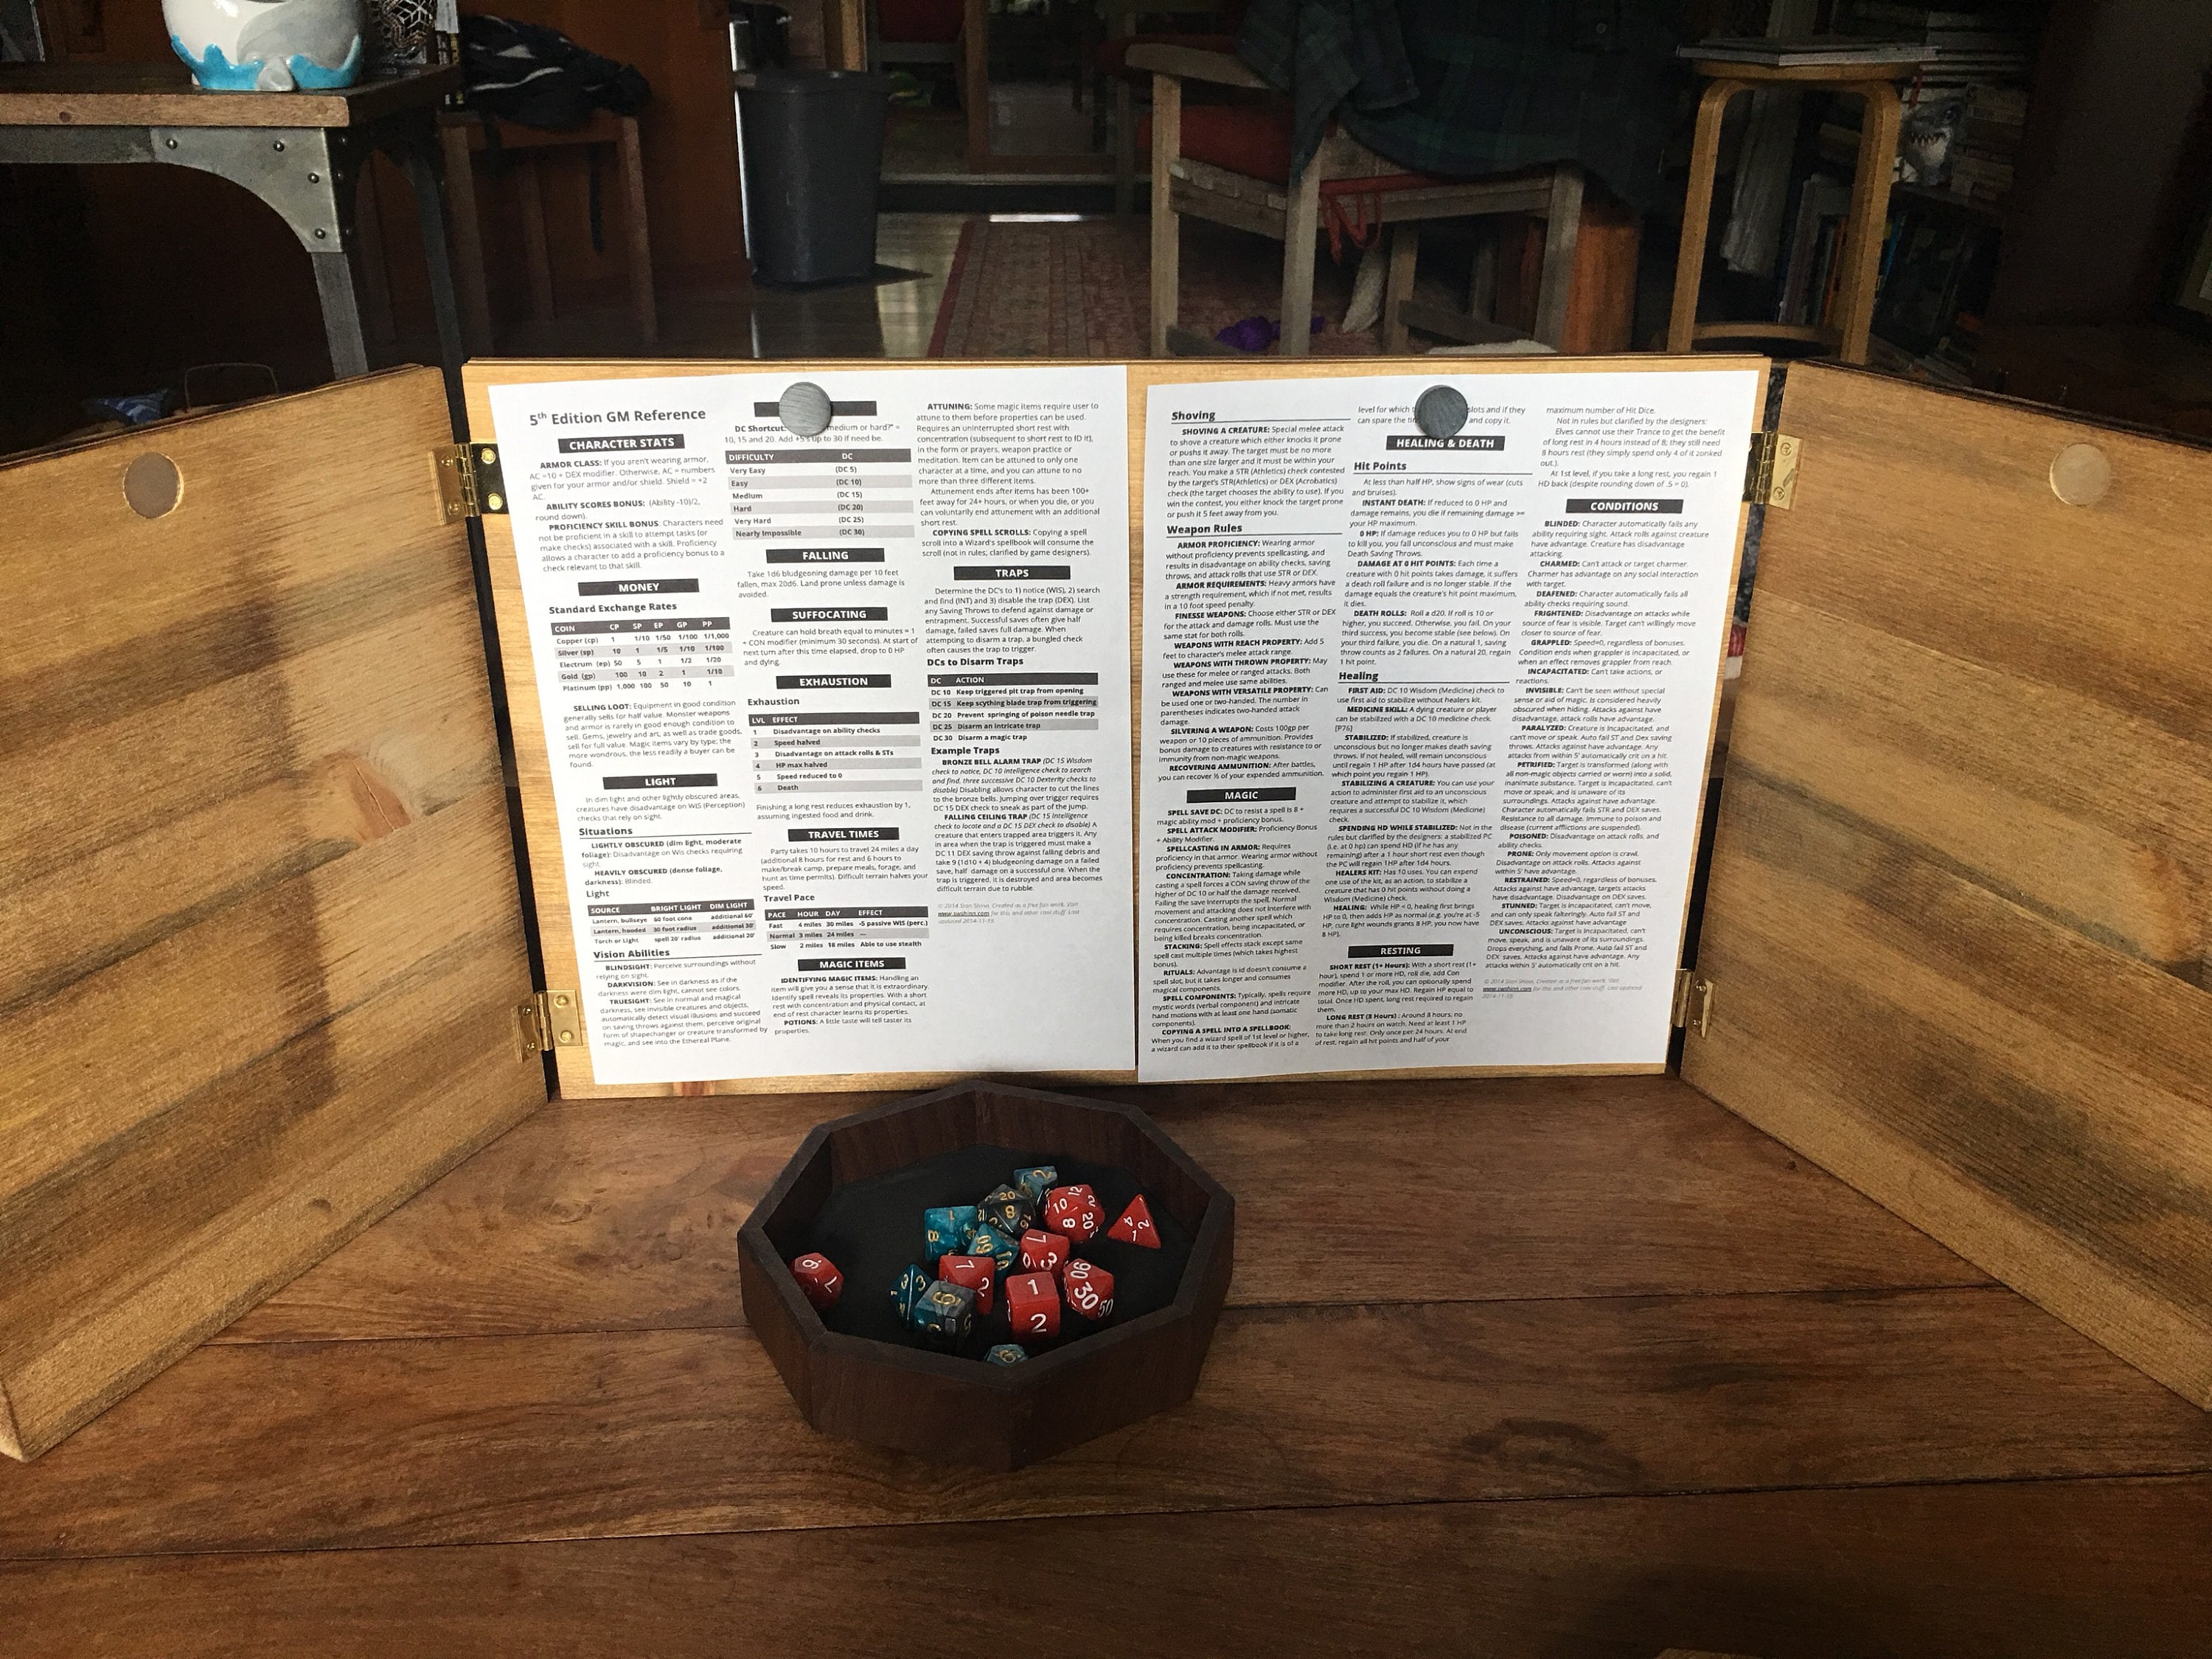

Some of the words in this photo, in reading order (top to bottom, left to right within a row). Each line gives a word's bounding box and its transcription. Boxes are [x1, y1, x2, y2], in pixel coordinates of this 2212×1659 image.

[927, 403, 973, 411] ATTUNING:
[974, 403, 996, 411] Some
[997, 403, 1020, 412] magic
[1020, 403, 1042, 411] items
[1043, 403, 1071, 411] require
[1357, 406, 1376, 414] level
[1376, 406, 1388, 414] for
[1388, 405, 1411, 414] which
[1486, 406, 1501, 414] and
[1502, 406, 1509, 414] if
[1509, 406, 1526, 416] they
[1546, 406, 1584, 414] maximum
[1585, 406, 1615, 414] number
[1615, 406, 1625, 414] of
[1625, 406, 1637, 414] Hit
[1638, 406, 1656, 414] Dice.
[551, 412, 602, 425] Edition
[606, 411, 630, 422] GM
[634, 409, 706, 422] Reference
[1171, 410, 1216, 422] Shoving
[1182, 428, 1219, 436] SHOVING
[1228, 426, 1270, 434] CREATURE:
[1271, 425, 1298, 434] Special
[568, 439, 639, 452] CHARACTER
[639, 437, 675, 448] STATS
[1397, 439, 1444, 448] HEALING
[1447, 439, 1456, 448] &
[1458, 439, 1495, 448] DEATH
[728, 453, 774, 462] DIFFICULTY
[540, 461, 572, 469] ARMOR
[574, 459, 602, 467] CLASS:
[610, 459, 626, 467] you
[627, 457, 650, 466] aren't
[650, 457, 682, 465] wearing
[1354, 461, 1371, 470] Hit
[1372, 461, 1407, 470] Points
[729, 467, 748, 476] Very
[748, 467, 766, 476] Easy
[835, 465, 849, 474] (DC
[546, 502, 578, 510] ABILITY
[580, 501, 612, 509] SCORES
[1590, 501, 1659, 511] CONDITIONS
[1166, 525, 1212, 538] Weapon
[1214, 524, 1242, 533] Rules
[802, 551, 849, 560] FALLING
[995, 568, 1029, 578] TRAPS
[618, 582, 661, 594] MONEY
[549, 605, 597, 614] Standard
[598, 603, 647, 613] Exchange
[649, 602, 678, 611] Rates
[792, 610, 866, 619] SUFFOCATING
[556, 638, 583, 646] Copper
[584, 637, 599, 645] (cp)
[927, 658, 945, 667] DCs
[947, 658, 959, 667] to
[960, 658, 995, 666] Disarm
[996, 657, 1024, 667] Traps
[799, 677, 869, 686] EXHAUSTION
[1338, 671, 1380, 683] Healing
[747, 697, 800, 706] Exhaustion
[1170, 727, 1210, 735] SILVERING
[1218, 726, 1254, 734] WEAPON:
[931, 746, 972, 757] Example
[973, 746, 1000, 757] Traps
[644, 777, 677, 787] LIGHT
[1225, 790, 1259, 800] MAGIC
[579, 827, 633, 836] Situations
[807, 830, 847, 839] TRAVEL
[848, 830, 880, 838] TIMES
[1166, 872, 1231, 880] CONCENTRATION:
[585, 890, 610, 900] Light
[763, 894, 792, 902] Travel
[593, 950, 625, 959] Vision
[627, 948, 670, 958] Abilities
[1380, 947, 1421, 955] RESTING
[819, 961, 853, 969] MAGIC
[855, 960, 885, 968] ITEMS
[1053, 1198, 1068, 1214] 10
[1005, 1205, 1015, 1219] 8
[1062, 1218, 1075, 1228] 8
[1133, 1230, 1137, 1242] 1
[1027, 1279, 1038, 1295] 1
[1074, 1281, 1099, 1310] 30
[1098, 1298, 1113, 1317] 50
[1030, 1313, 1047, 1332] 2
